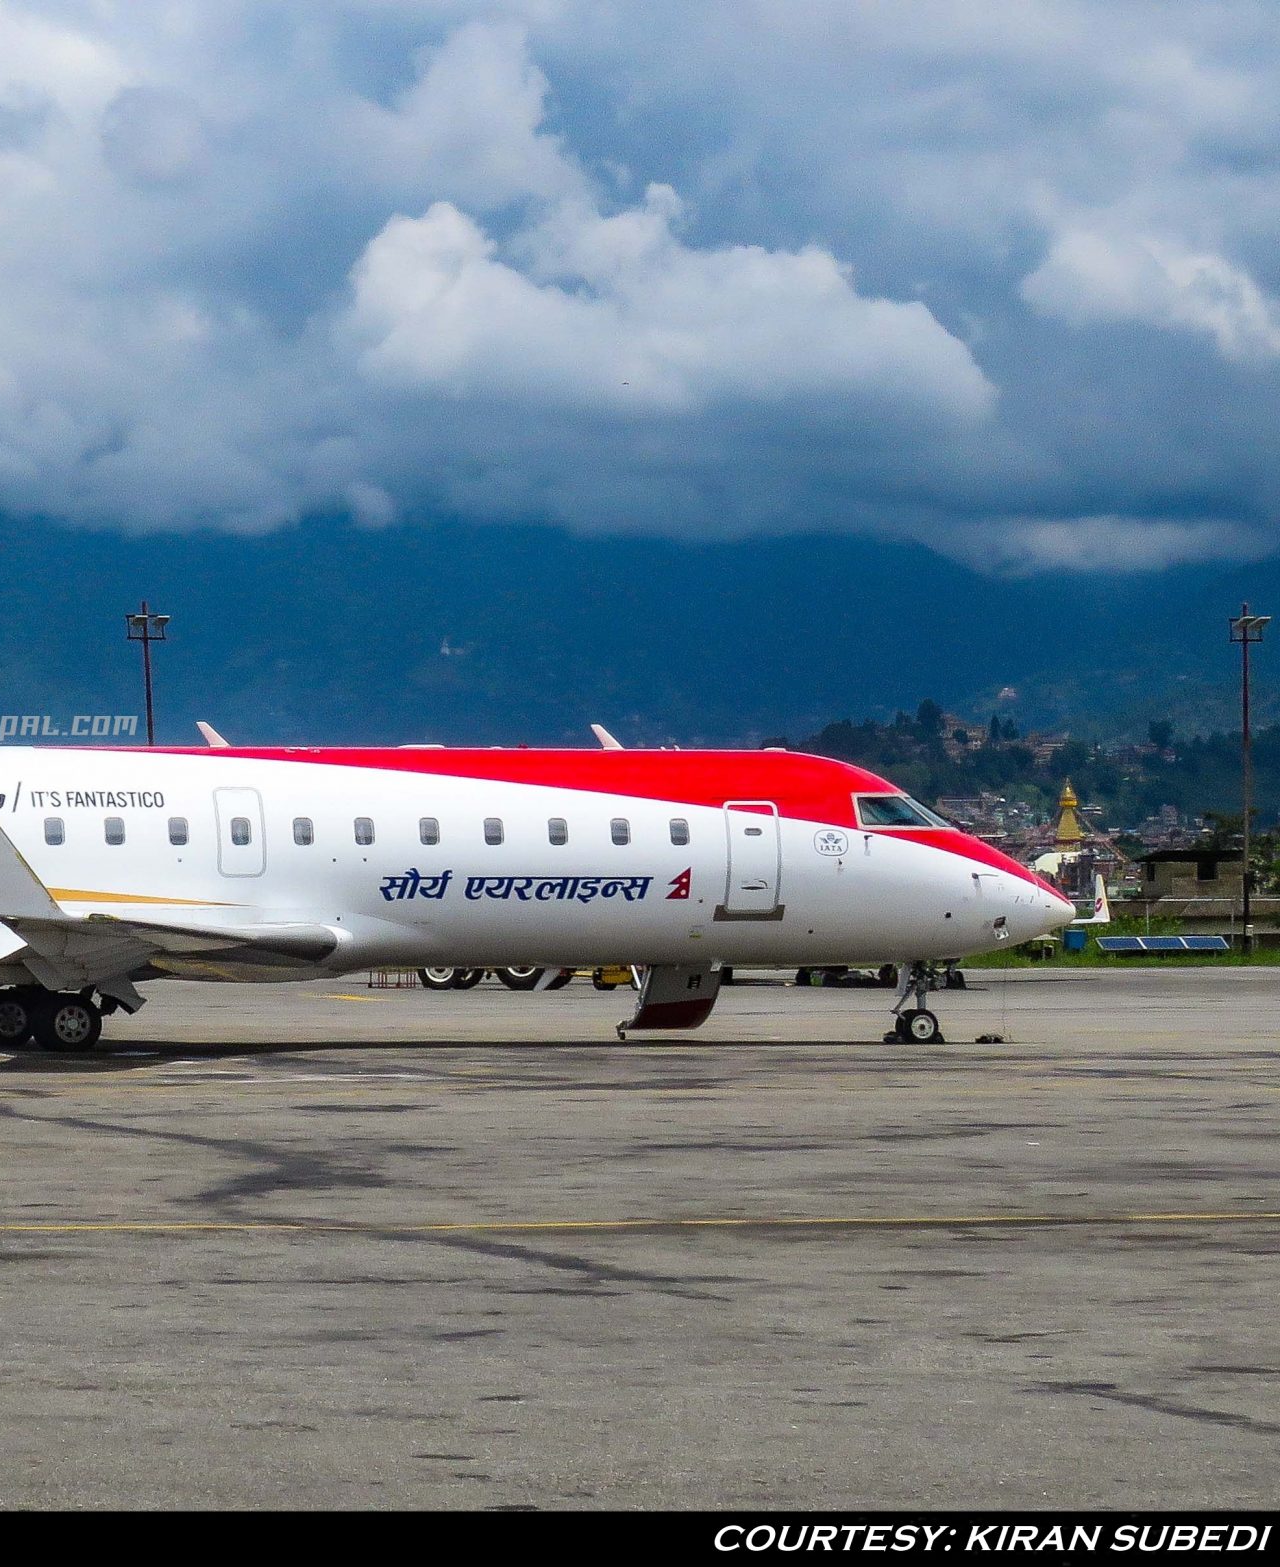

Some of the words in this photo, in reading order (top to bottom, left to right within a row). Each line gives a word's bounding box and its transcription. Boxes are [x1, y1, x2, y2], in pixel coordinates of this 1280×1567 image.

[30, 791, 62, 808] IT'S
[66, 791, 165, 808] FANTASTICO
[379, 867, 453, 901] सौर्य
[464, 876, 654, 903] एयरलाइन्स
